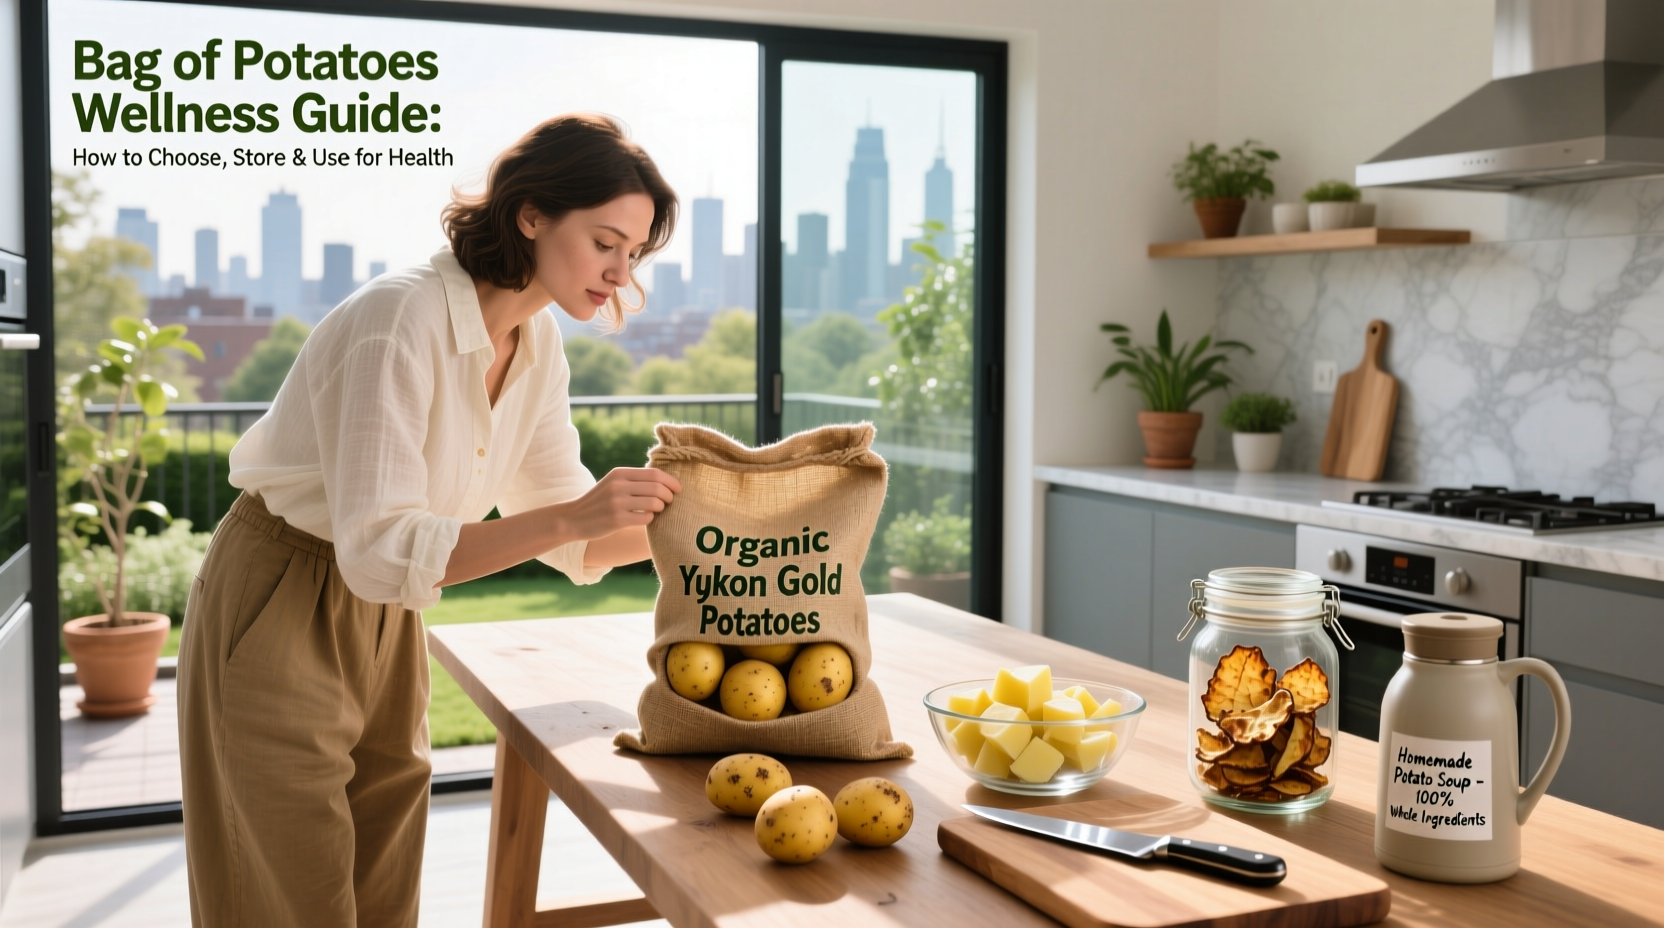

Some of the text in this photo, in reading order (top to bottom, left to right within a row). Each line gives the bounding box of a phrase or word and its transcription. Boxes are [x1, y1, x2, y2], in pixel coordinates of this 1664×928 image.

[696, 526, 830, 568] Organic
[679, 563, 842, 604] Yukon Gold
[700, 605, 820, 636] Potatoes
[1398, 746, 1473, 769] Homemade
[1394, 766, 1433, 785] Potato
[1437, 772, 1471, 794] Soup
[1416, 790, 1454, 807] 100%
[1422, 810, 1486, 829] Ingredients
